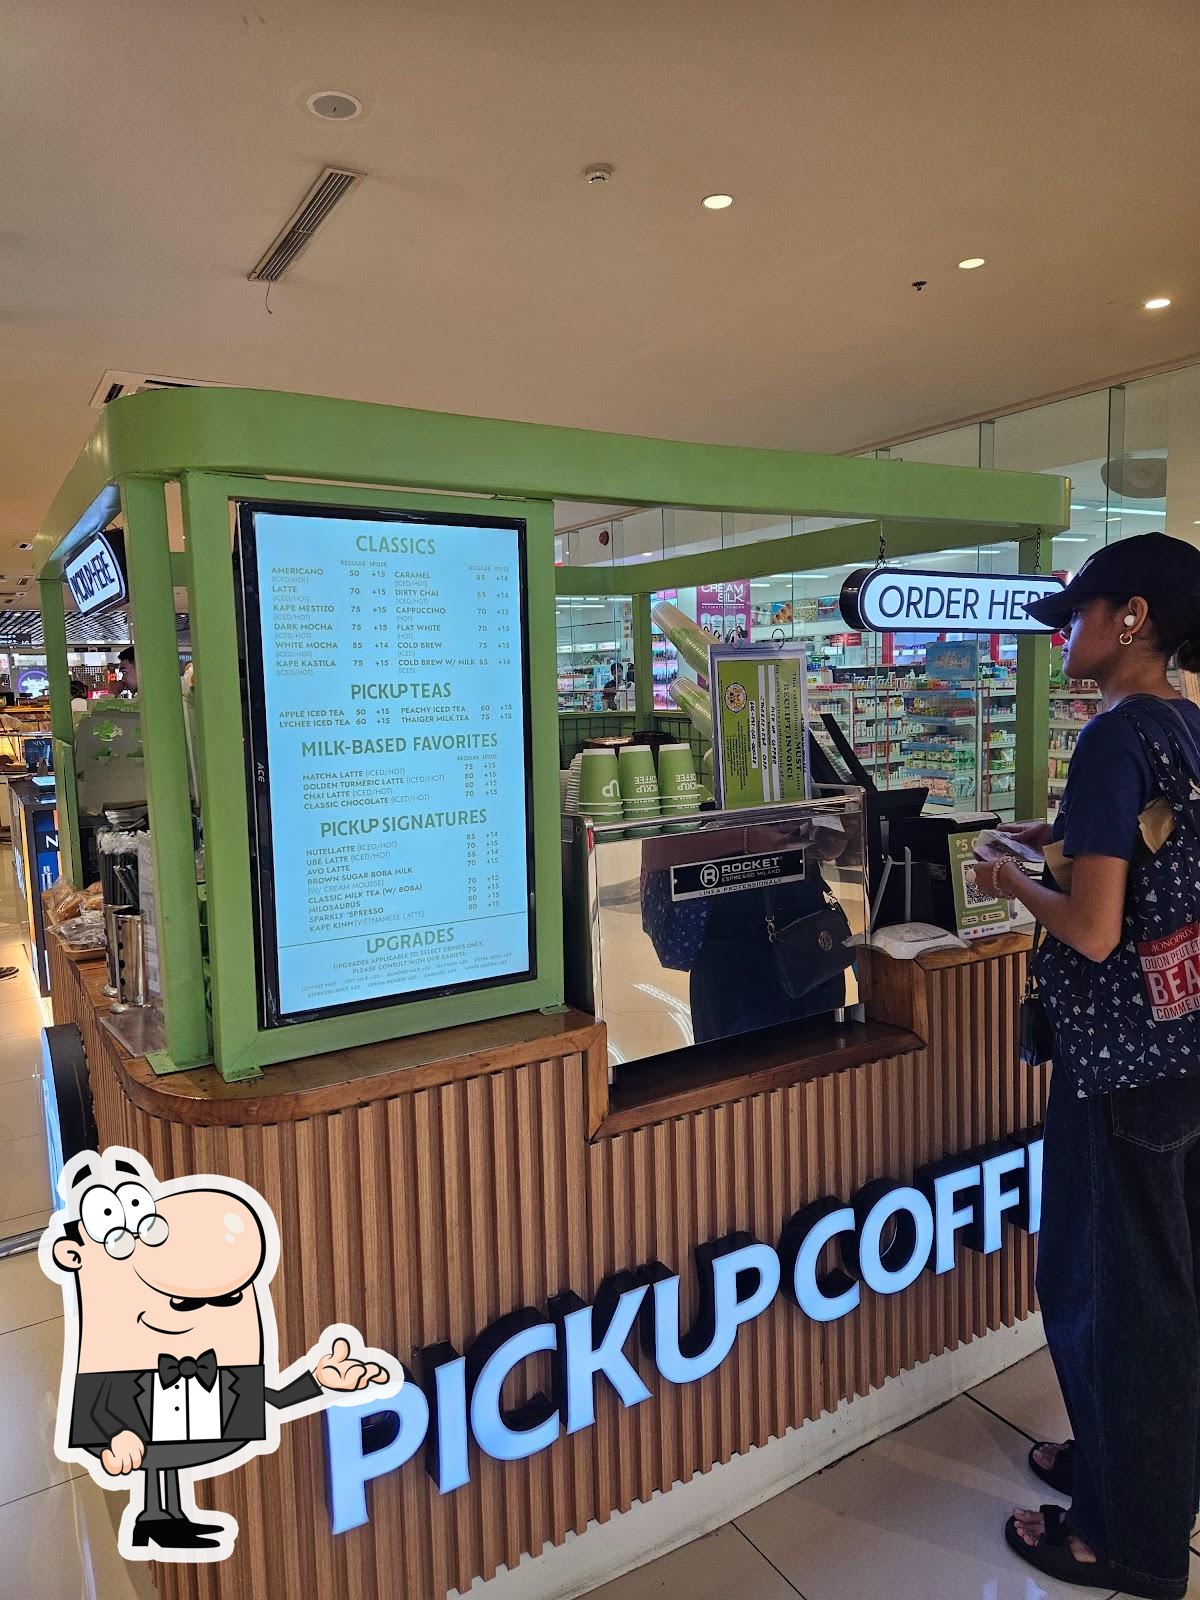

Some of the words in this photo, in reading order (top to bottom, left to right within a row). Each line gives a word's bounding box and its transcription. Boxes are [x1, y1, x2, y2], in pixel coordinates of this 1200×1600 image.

[356, 535, 436, 555] CLASSICS
[272, 567, 324, 576] AMERICANO
[273, 585, 298, 593] LATTE
[350, 588, 360, 596] 70
[395, 589, 417, 597] DIRTY
[701, 583, 744, 593] CREAM
[717, 593, 745, 603] SILK
[879, 584, 980, 620] ORDER
[273, 604, 296, 612] KAPE
[298, 604, 335, 613] MESTIZO
[351, 605, 361, 613] 75
[373, 606, 387, 614] +15
[396, 606, 446, 615] CAPPUCCINO
[274, 623, 298, 631] DARK
[301, 623, 333, 631] MOCHA
[352, 623, 362, 631] 75
[373, 624, 388, 632] +15
[397, 624, 414, 633] FLAT
[416, 624, 441, 632] WHITE
[275, 641, 304, 650] WHITE
[306, 641, 338, 650] MOCHA
[397, 641, 418, 650] COLD
[420, 641, 443, 650] BREW
[276, 659, 299, 668] KAPE
[301, 659, 336, 668] KASTILA
[353, 659, 363, 667] 75
[374, 659, 389, 668] +15
[398, 658, 419, 667] COLD
[421, 658, 443, 667] BREW
[445, 658, 456, 667] W/
[458, 658, 476, 667] MILK
[351, 683, 408, 700] PICKUP
[410, 682, 453, 700] TEAS
[278, 711, 305, 719] APPLE
[307, 710, 327, 718] ICED
[329, 709, 345, 717] TEA
[356, 708, 367, 716] 50
[376, 707, 390, 716] +15
[401, 705, 433, 714] PEACHY
[433, 705, 450, 713] ICED
[452, 704, 466, 712] TEA
[279, 720, 312, 729] LYCHEE
[313, 719, 333, 727] ICED
[335, 718, 351, 726] TEA
[356, 717, 367, 725] 60
[376, 716, 390, 725] +15
[401, 714, 434, 724] THAIGER
[436, 713, 454, 723] MILK
[455, 713, 470, 721] TEA
[480, 713, 490, 721] 75
[783, 684, 793, 781] RECEIPT/INVOICE
[301, 736, 407, 757] MILK-BASED
[413, 732, 498, 752] FAVORITES
[303, 772, 338, 781] MATCHA
[340, 770, 364, 778] LATTE
[365, 768, 405, 778] (ICED/HOT)
[303, 782, 338, 791] GOLDEN
[340, 779, 380, 789] TURMERIC
[382, 777, 404, 786] LATTE
[406, 774, 445, 784] (ICED/HOT)
[303, 792, 326, 801] CHAI
[327, 789, 350, 798] LATTE
[352, 787, 392, 798] (ICED/HOT)
[304, 801, 338, 810] CLASSIC
[340, 796, 389, 808] CHOCOLATE
[390, 794, 429, 804] (ICED/HOT)
[320, 818, 379, 838] PICKUP
[382, 808, 487, 833] SIGNATURES
[306, 845, 355, 857] NUTELLATTE
[306, 857, 323, 866] UBE
[324, 854, 349, 864] LATTE
[721, 857, 780, 873] ROCKET
[306, 866, 325, 876] AVO
[326, 864, 350, 874] LATTE
[307, 875, 340, 885] BROWN
[341, 872, 369, 882] SUGAR
[371, 869, 393, 878] BOBA
[394, 866, 414, 876] MILK
[721, 872, 755, 882] ESPRESSO
[757, 867, 781, 877] MILANO
[323, 882, 350, 893] CREAM
[351, 878, 385, 890] MOUSSE)
[698, 888, 721, 897] LINEA
[723, 877, 784, 893] PROFESSIONALE
[307, 893, 342, 905] CLASSIC
[344, 890, 365, 900] MILK
[366, 888, 382, 898] TEA
[398, 882, 423, 893] BOBA)
[308, 900, 361, 914] MILOSAURUS
[309, 912, 344, 924] SPARKLY
[309, 922, 331, 933] KAPE
[333, 920, 354, 930] KINH
[366, 927, 456, 954] UPGRADES
[333, 960, 369, 971] UPGRADES
[371, 953, 410, 965] APPLICABLE
[443, 944, 466, 953] DRINKS
[1170, 944, 1190, 964] PEUT
[352, 965, 376, 975] PLEASE
[378, 960, 408, 971] CONSULT
[1147, 957, 1200, 1005] BEA
[1156, 998, 1192, 1020] COMME
[326, 1243, 781, 1535] PICKUP
